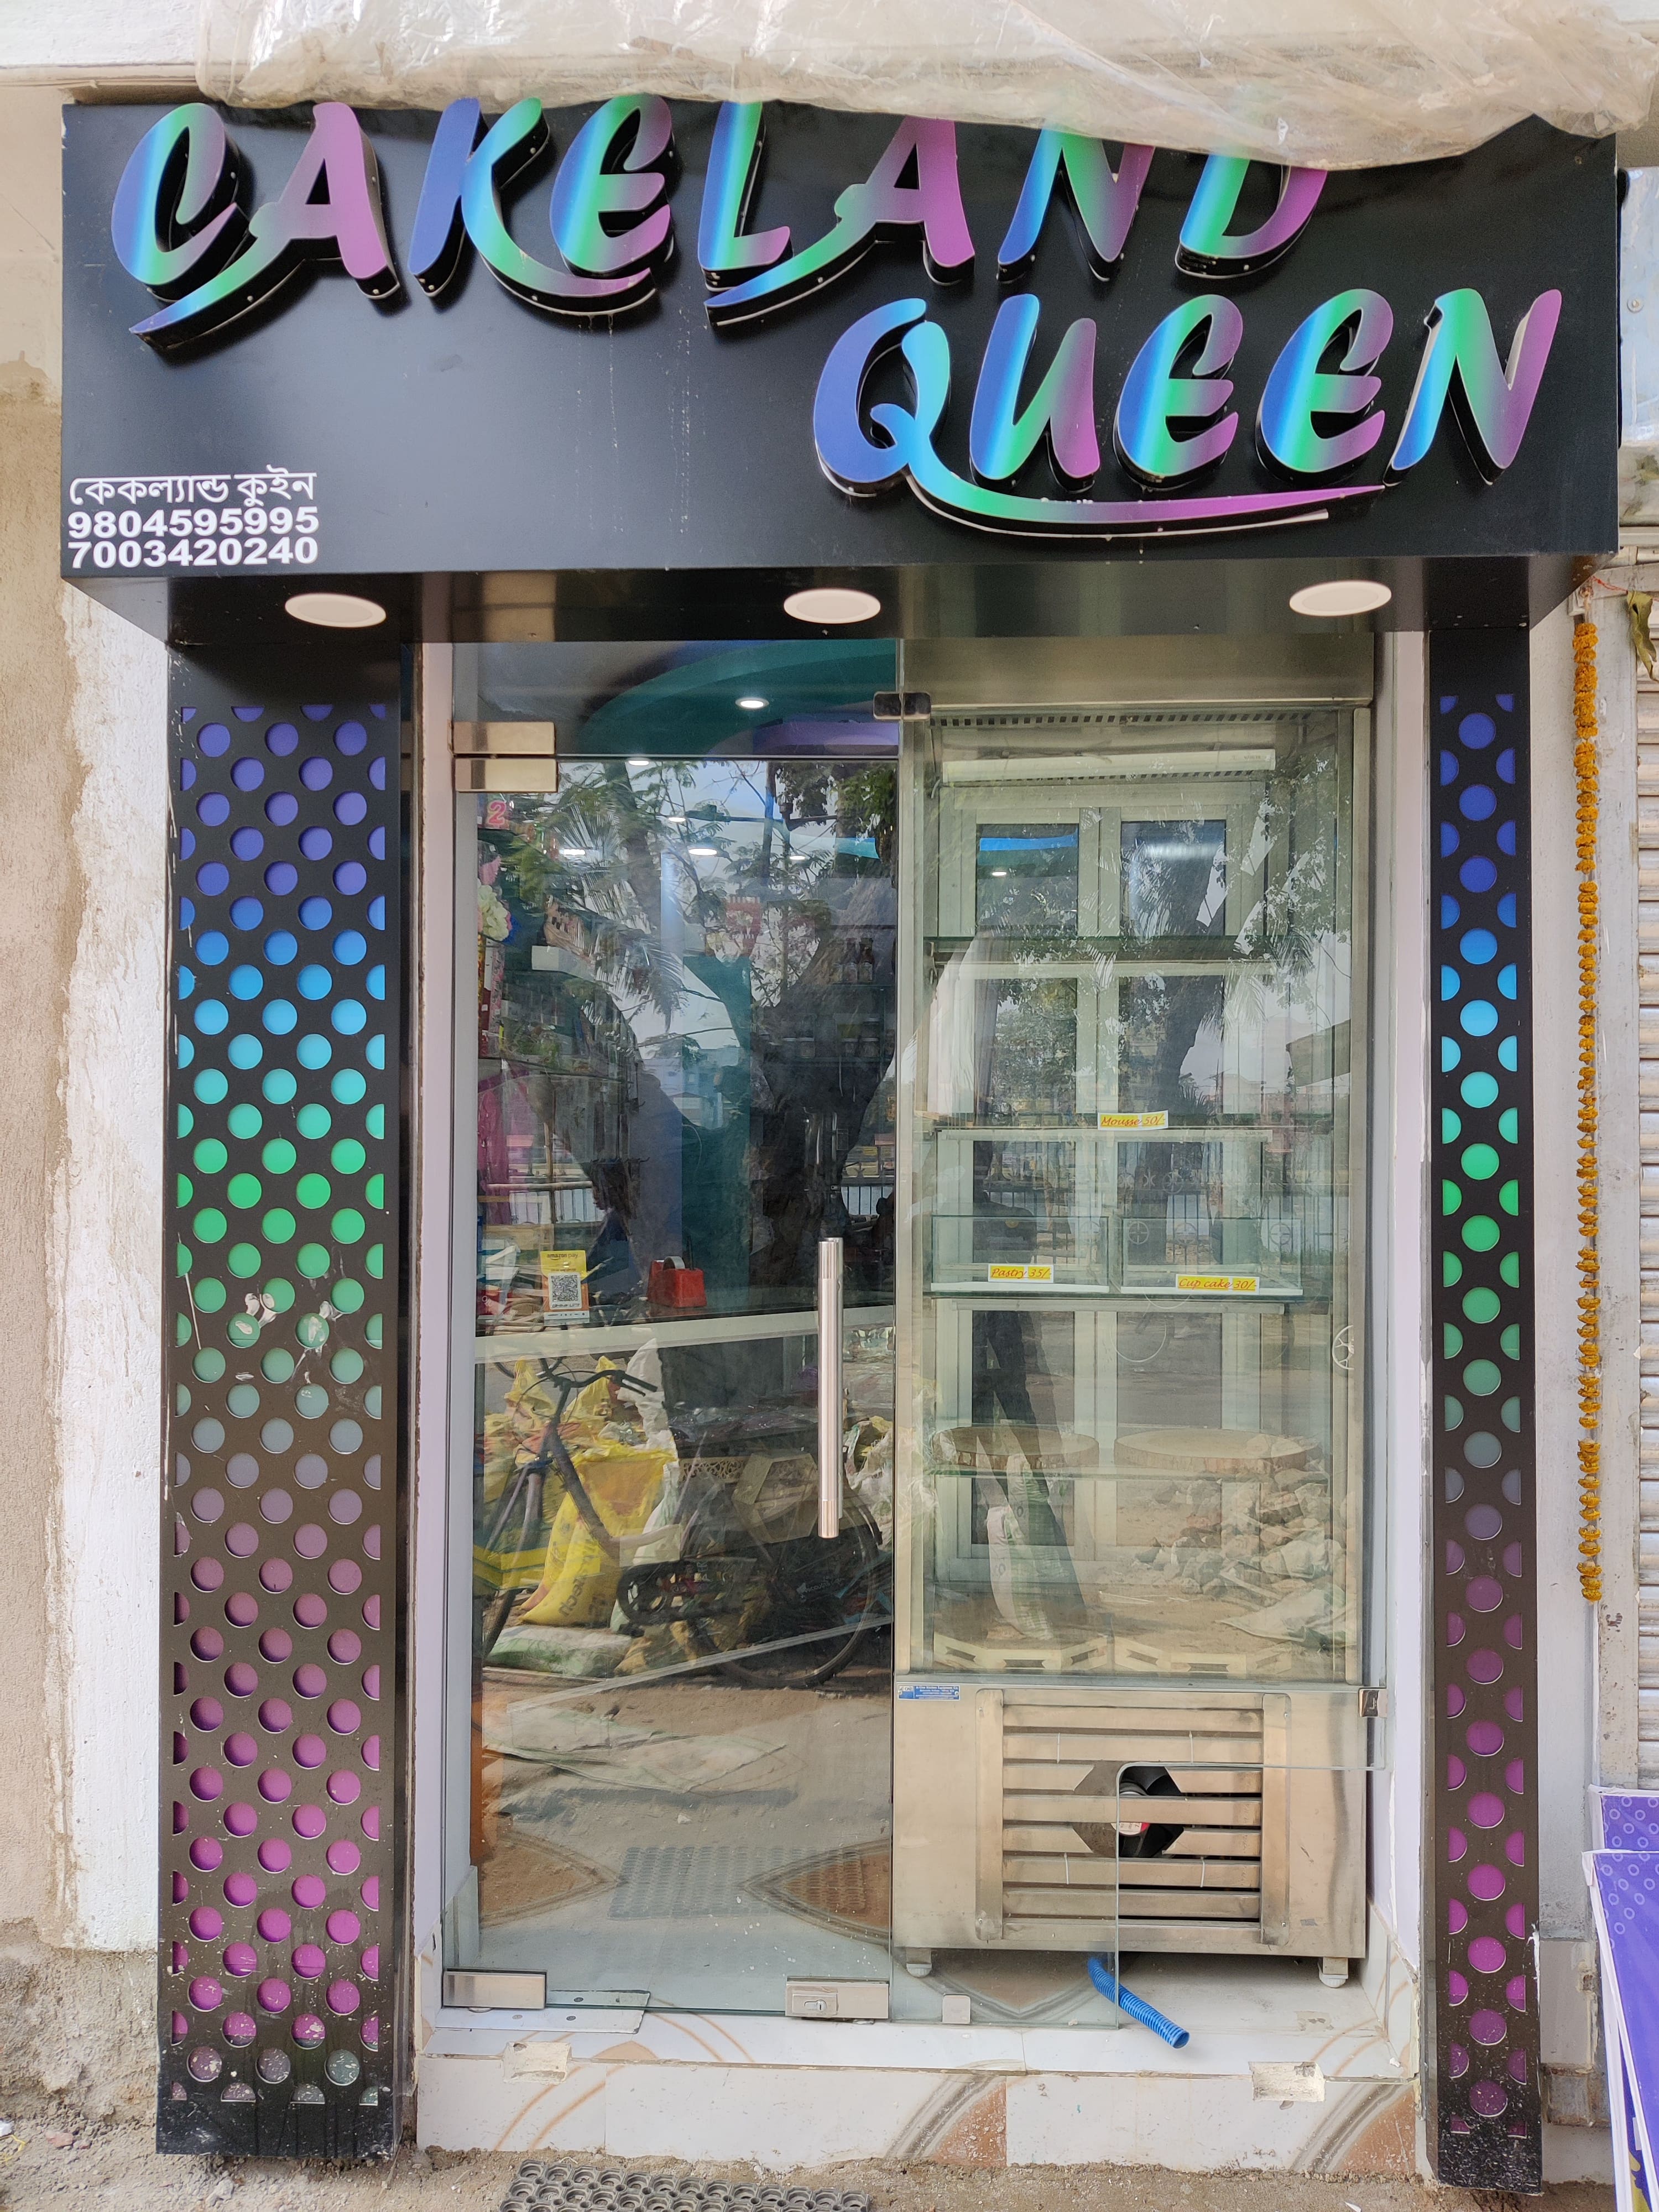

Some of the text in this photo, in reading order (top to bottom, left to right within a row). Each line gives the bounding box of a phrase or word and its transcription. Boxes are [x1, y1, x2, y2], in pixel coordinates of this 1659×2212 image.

[111, 96, 1328, 333] CAKELAND
[813, 288, 1562, 523] QUEEN
[70, 464, 317, 507] কেকল্যান্ড কুইন
[67, 506, 319, 539] 9804595995
[67, 536, 319, 568] 7003420240
[489, 800, 507, 825] 2
[1101, 1113, 1166, 1126] Mousse 50/-
[991, 1268, 1052, 1279] Pastry 35/-
[1179, 1278, 1257, 1290] Cup cake 30/-
